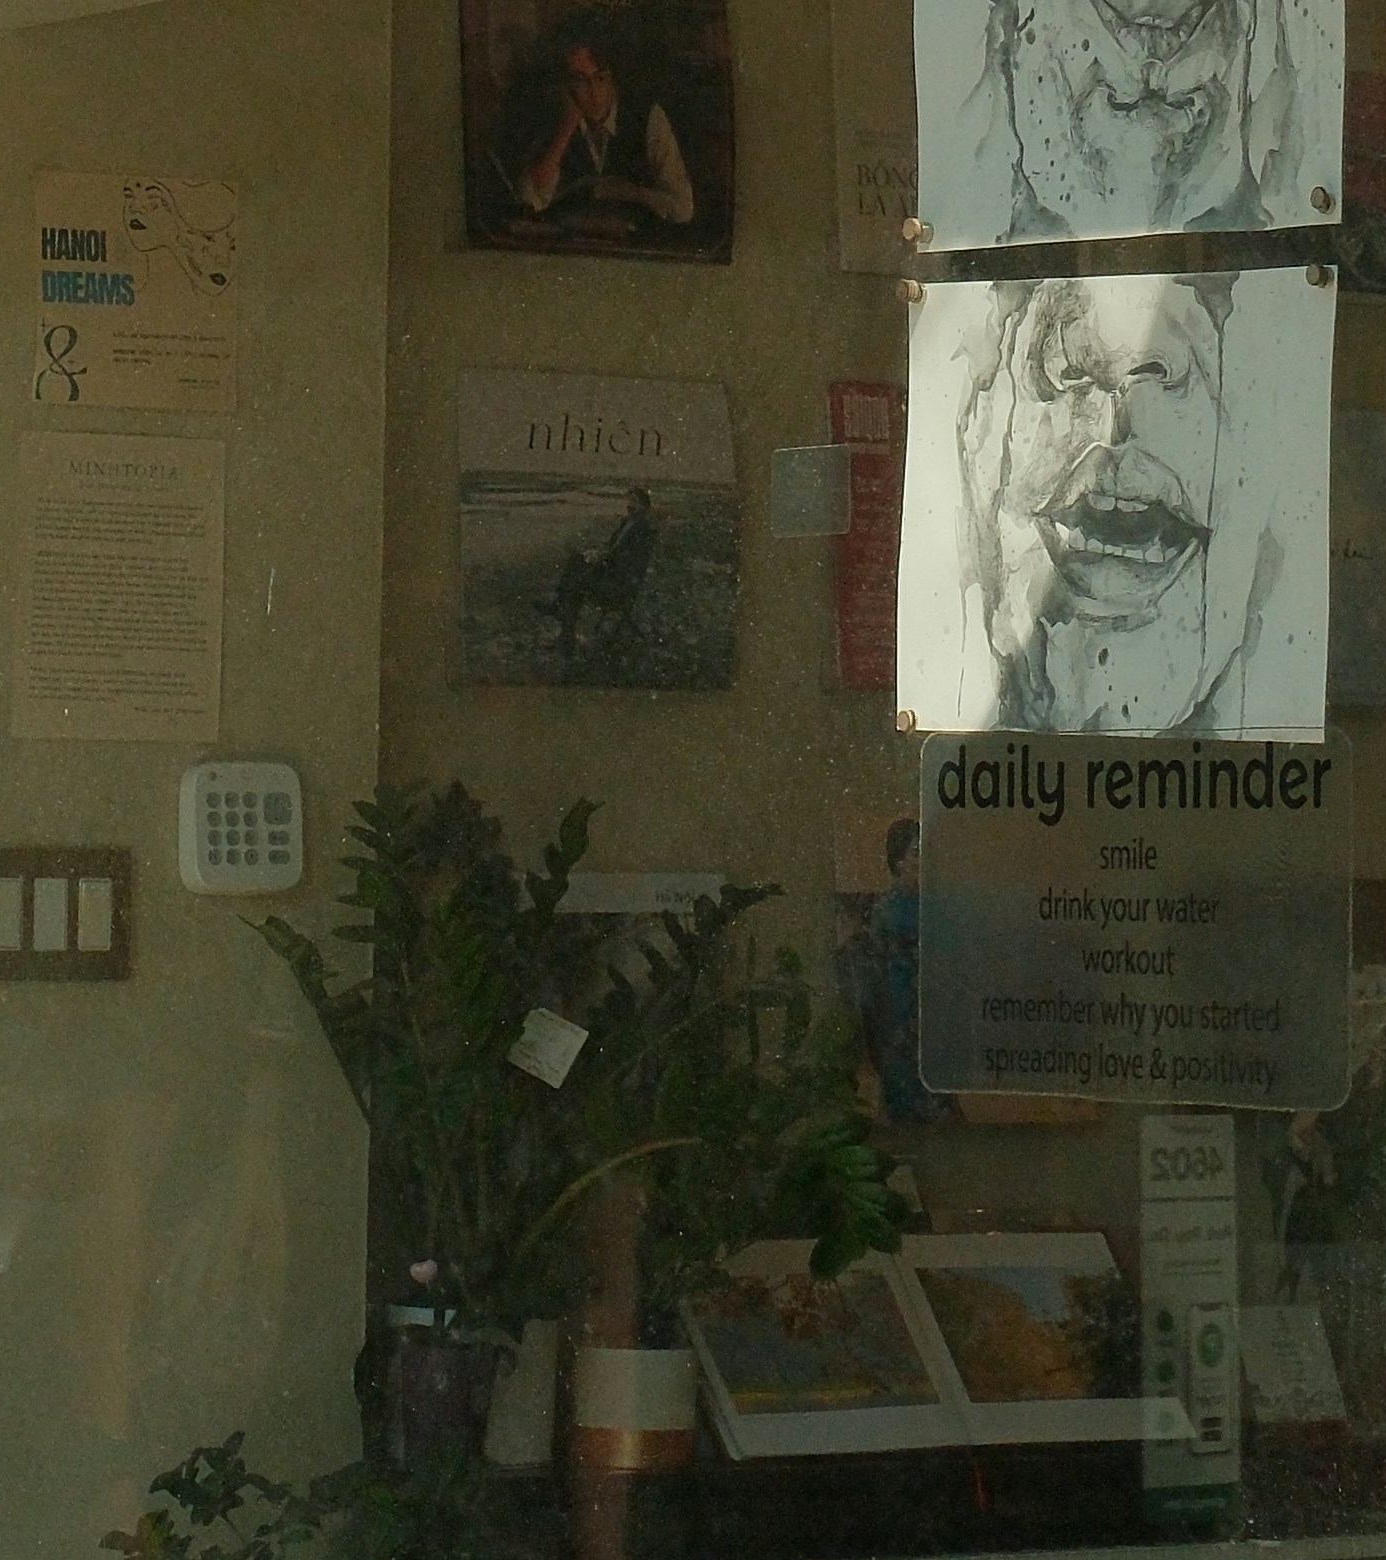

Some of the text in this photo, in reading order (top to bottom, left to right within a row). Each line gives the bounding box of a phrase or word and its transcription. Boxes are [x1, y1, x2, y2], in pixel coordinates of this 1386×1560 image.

[41, 227, 107, 263] HANOI
[42, 270, 136, 307] DREAMS
[937, 743, 1332, 826] daily reminder
[1099, 838, 1157, 870] smile
[1039, 887, 1221, 929] drink your water
[1082, 945, 1176, 976] workout
[981, 992, 1281, 1035] remember why you started
[984, 1045, 1278, 1093] spreading love & positivity
